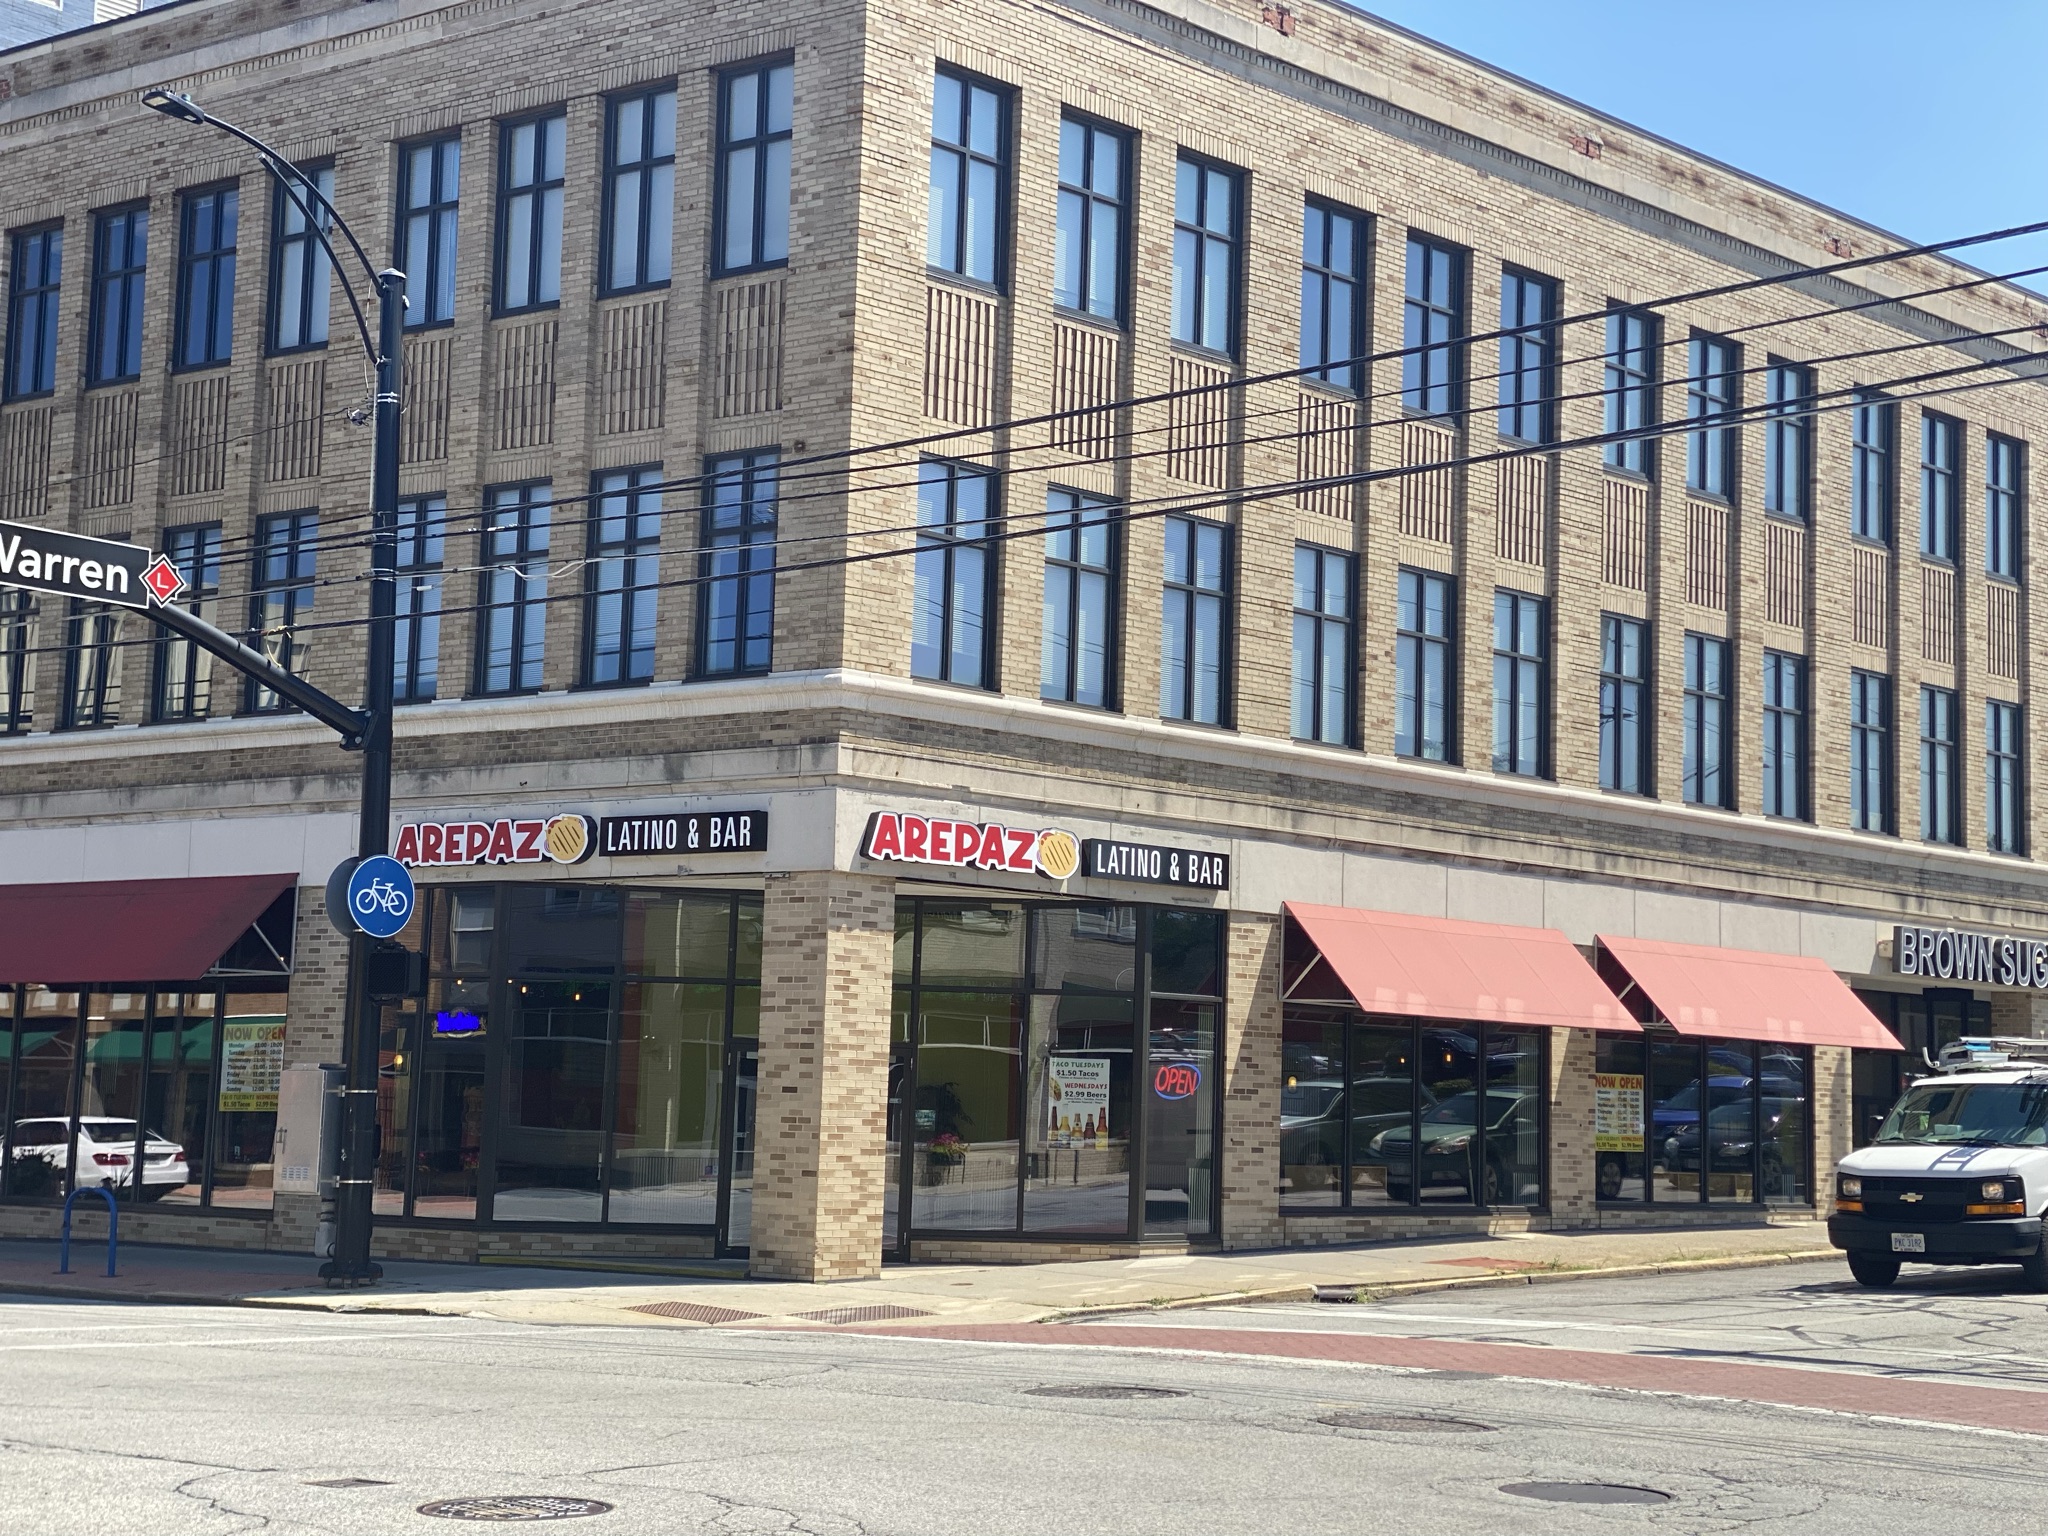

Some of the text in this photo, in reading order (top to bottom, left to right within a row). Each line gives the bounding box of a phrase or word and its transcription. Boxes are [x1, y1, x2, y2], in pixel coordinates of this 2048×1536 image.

[396, 815, 751, 865] AREPAZ LATINO & BAR
[872, 814, 1223, 886] AREPAZ LATINO & BAR
[1900, 926, 2048, 989] BROWN SUG
[225, 1026, 286, 1041] NOW OPEN
[1071, 1061, 1104, 1069] TUESDAYS
[1078, 1070, 1099, 1078] Tacos
[1155, 1066, 1198, 1096] OPEN
[1595, 1076, 1642, 1089] NOW OPEN
[1064, 1090, 1085, 1098] $2.99
